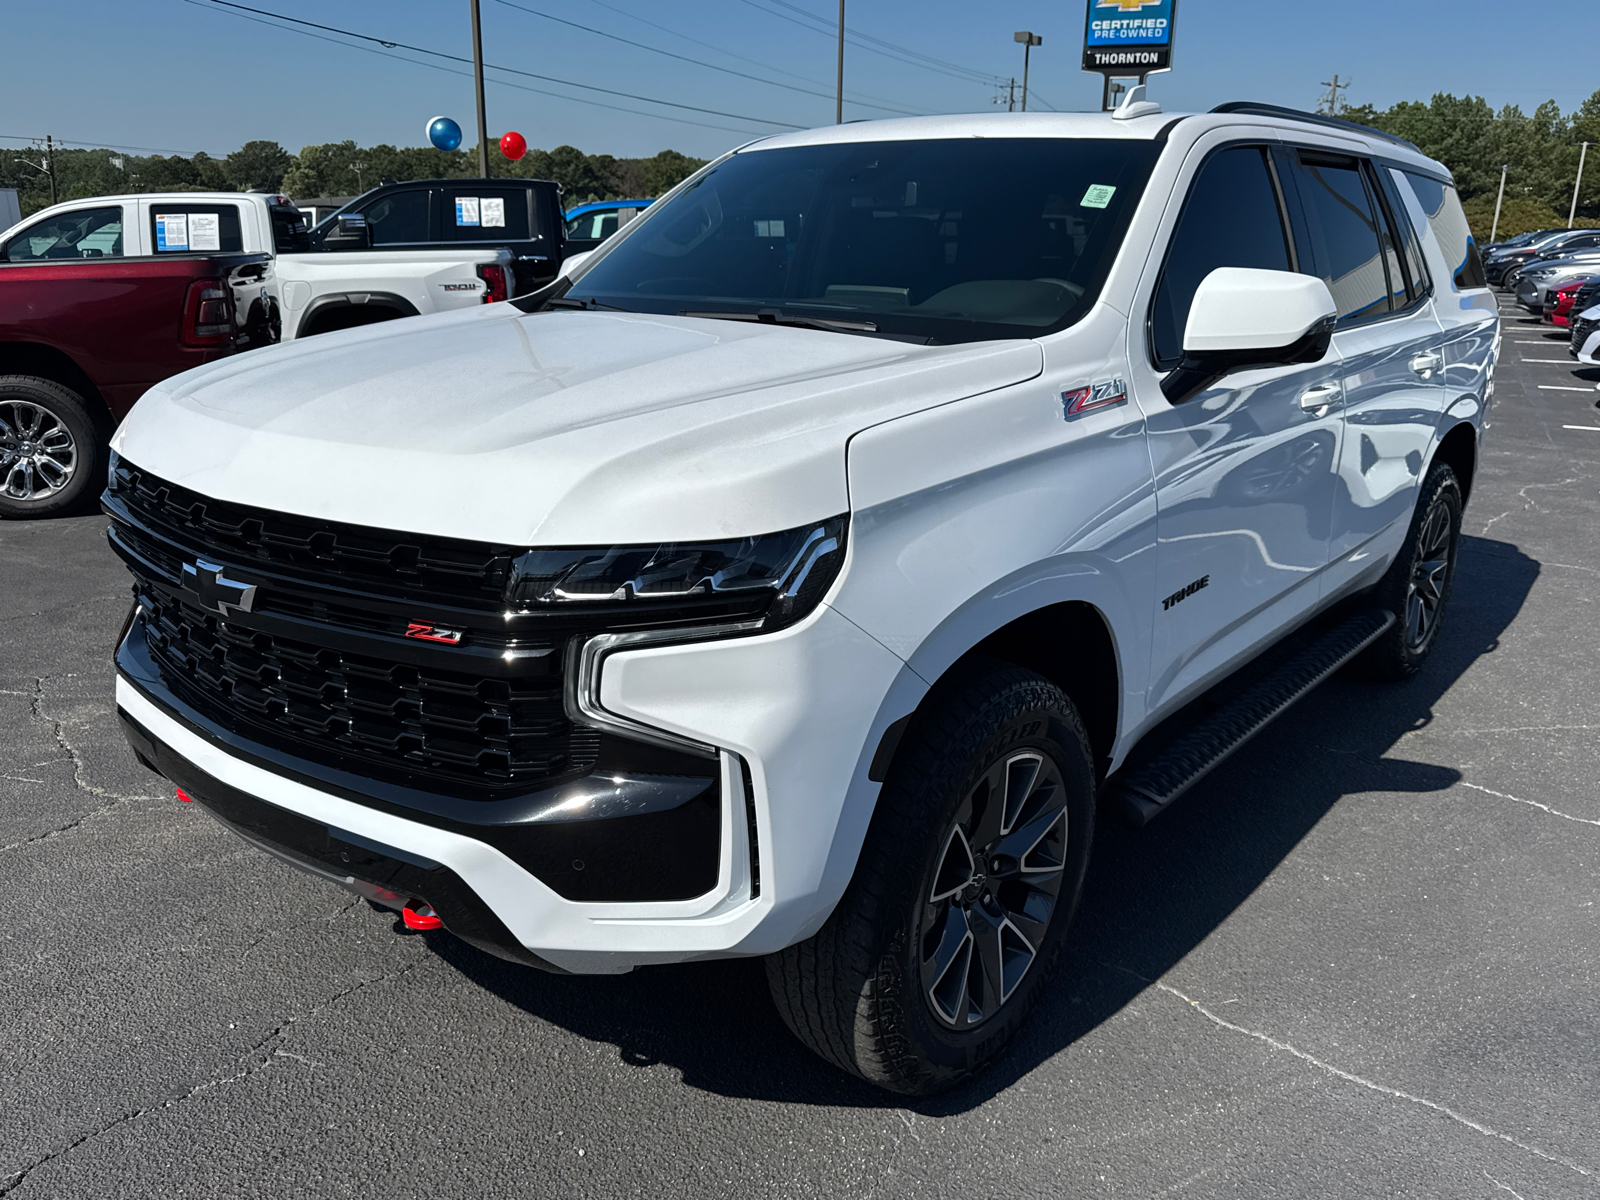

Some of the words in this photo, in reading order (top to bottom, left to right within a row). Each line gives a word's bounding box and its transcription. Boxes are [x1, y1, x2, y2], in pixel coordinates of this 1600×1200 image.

[1091, 18, 1167, 30] CERTIFIED
[1094, 28, 1163, 39] PRE-OWNED
[1094, 52, 1159, 65] THORNTON
[1062, 379, 1127, 418] Z71
[1161, 574, 1210, 611] TAHOE
[405, 623, 463, 644] Z71
